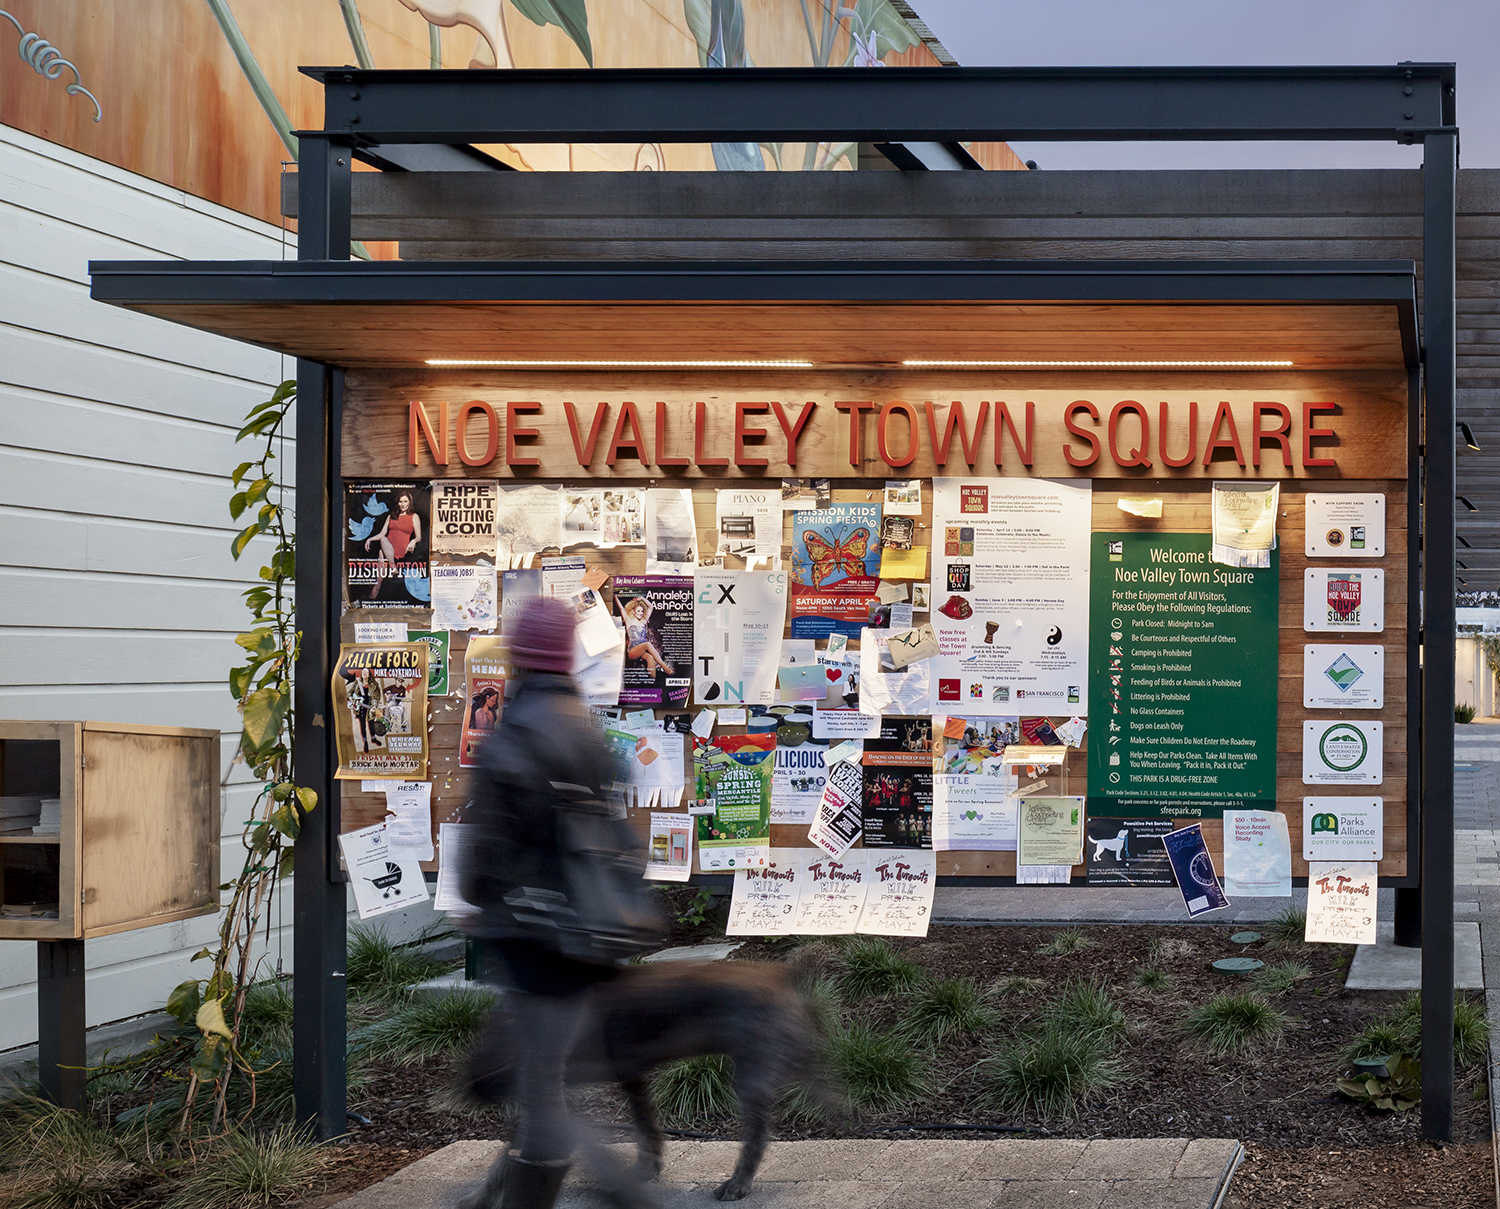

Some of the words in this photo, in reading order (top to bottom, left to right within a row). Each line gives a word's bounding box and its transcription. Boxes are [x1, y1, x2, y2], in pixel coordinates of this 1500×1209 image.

[408, 400, 541, 467] NOE
[563, 401, 817, 467] VALLEY
[834, 400, 1034, 467] TOWN
[1062, 400, 1336, 469] SQUARE
[443, 486, 489, 497] RIPE
[437, 498, 495, 509] FRUIT
[733, 495, 766, 503] PIANO
[798, 507, 848, 516] MISSION
[849, 507, 876, 516] KIDS
[965, 504, 984, 512] SQUARE
[438, 510, 494, 522] WRITING
[797, 516, 834, 524] SPRING
[836, 516, 875, 525] FIESTA
[440, 523, 492, 534] .COM
[1150, 548, 1204, 563] Welcome
[348, 562, 427, 579] DISRUPTION
[434, 569, 458, 577] TEACHING
[459, 569, 475, 577] JOBS!
[949, 573, 969, 583] OUT
[1115, 567, 1138, 582] Noe
[1140, 568, 1176, 586] Valley
[1178, 568, 1210, 583] Town
[1213, 569, 1254, 587] Square
[1329, 583, 1347, 592] BUILD
[1349, 583, 1359, 592] THE
[646, 590, 693, 601] Annaleigh
[1112, 590, 1124, 599] For
[1125, 590, 1137, 599] the
[1139, 591, 1177, 602] Enjoyment
[1178, 591, 1187, 600] of
[1187, 591, 1197, 600] All
[1199, 591, 1227, 602] Visitors,
[1329, 591, 1339, 599] NOE
[1340, 592, 1360, 600] VALLEY
[651, 601, 693, 611] Ashford
[796, 598, 838, 606] SATURDAY
[839, 598, 863, 606] APRIL
[1333, 600, 1356, 610] TOWN
[1112, 602, 1135, 612] Please
[1137, 602, 1155, 614] Obey
[1156, 603, 1169, 612] the
[1170, 603, 1205, 614] Following
[1207, 603, 1251, 615] Regulations:
[1327, 611, 1360, 622] SQUARE
[1132, 619, 1144, 627] Park
[1145, 620, 1165, 628] Closed:
[1167, 620, 1193, 629] Midnight
[1131, 649, 1156, 658] Camping
[1157, 649, 1162, 657] is
[345, 651, 383, 668] SALLIE
[386, 651, 419, 668] FORD
[374, 669, 388, 678] MIKE
[471, 665, 506, 675] HENA
[1130, 722, 1144, 731] Dogs
[1154, 722, 1170, 730] Leash
[1171, 723, 1184, 731] Only
[774, 750, 825, 768] LICIOUS
[723, 769, 756, 781] SUNSET
[1130, 775, 1142, 783] THIS
[1143, 775, 1158, 783] PARK
[1159, 775, 1164, 783] IS
[1165, 775, 1170, 783] A
[1171, 775, 1201, 783] DRUG-FREE
[716, 780, 762, 790] SPRING
[935, 776, 969, 785] LITTLE
[948, 786, 977, 795] Tweets
[1160, 807, 1202, 817] sfrecpark.org
[1340, 817, 1364, 826] Parks
[1340, 827, 1375, 836] Alliance
[819, 838, 839, 856] NOW!
[809, 863, 827, 880] The
[875, 864, 894, 882] The
[753, 881, 784, 893] MILK
[887, 882, 917, 894] MILK
[1316, 877, 1334, 895] The
[745, 919, 771, 930] MAY
[877, 919, 903, 930] MAY
[1325, 928, 1352, 937] MAY
